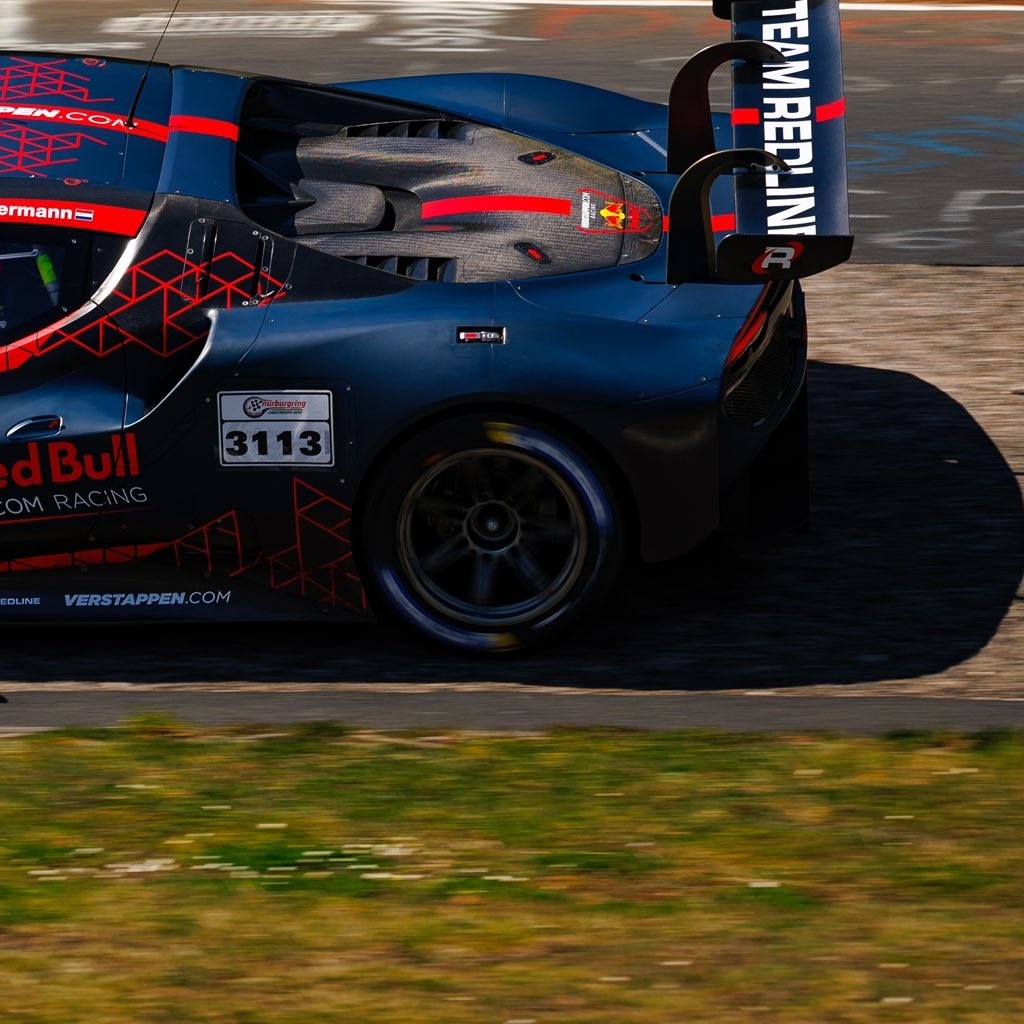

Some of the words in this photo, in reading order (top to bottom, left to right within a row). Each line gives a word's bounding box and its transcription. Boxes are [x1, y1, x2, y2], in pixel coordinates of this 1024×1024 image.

[762, 0, 810, 90] TEAM
[262, 399, 307, 409] nürburgring
[225, 430, 322, 456] 3113
[48, 432, 140, 484] Bull
[54, 486, 148, 511] RACING
[64, 590, 232, 607] VERSTAPPEN.COM
